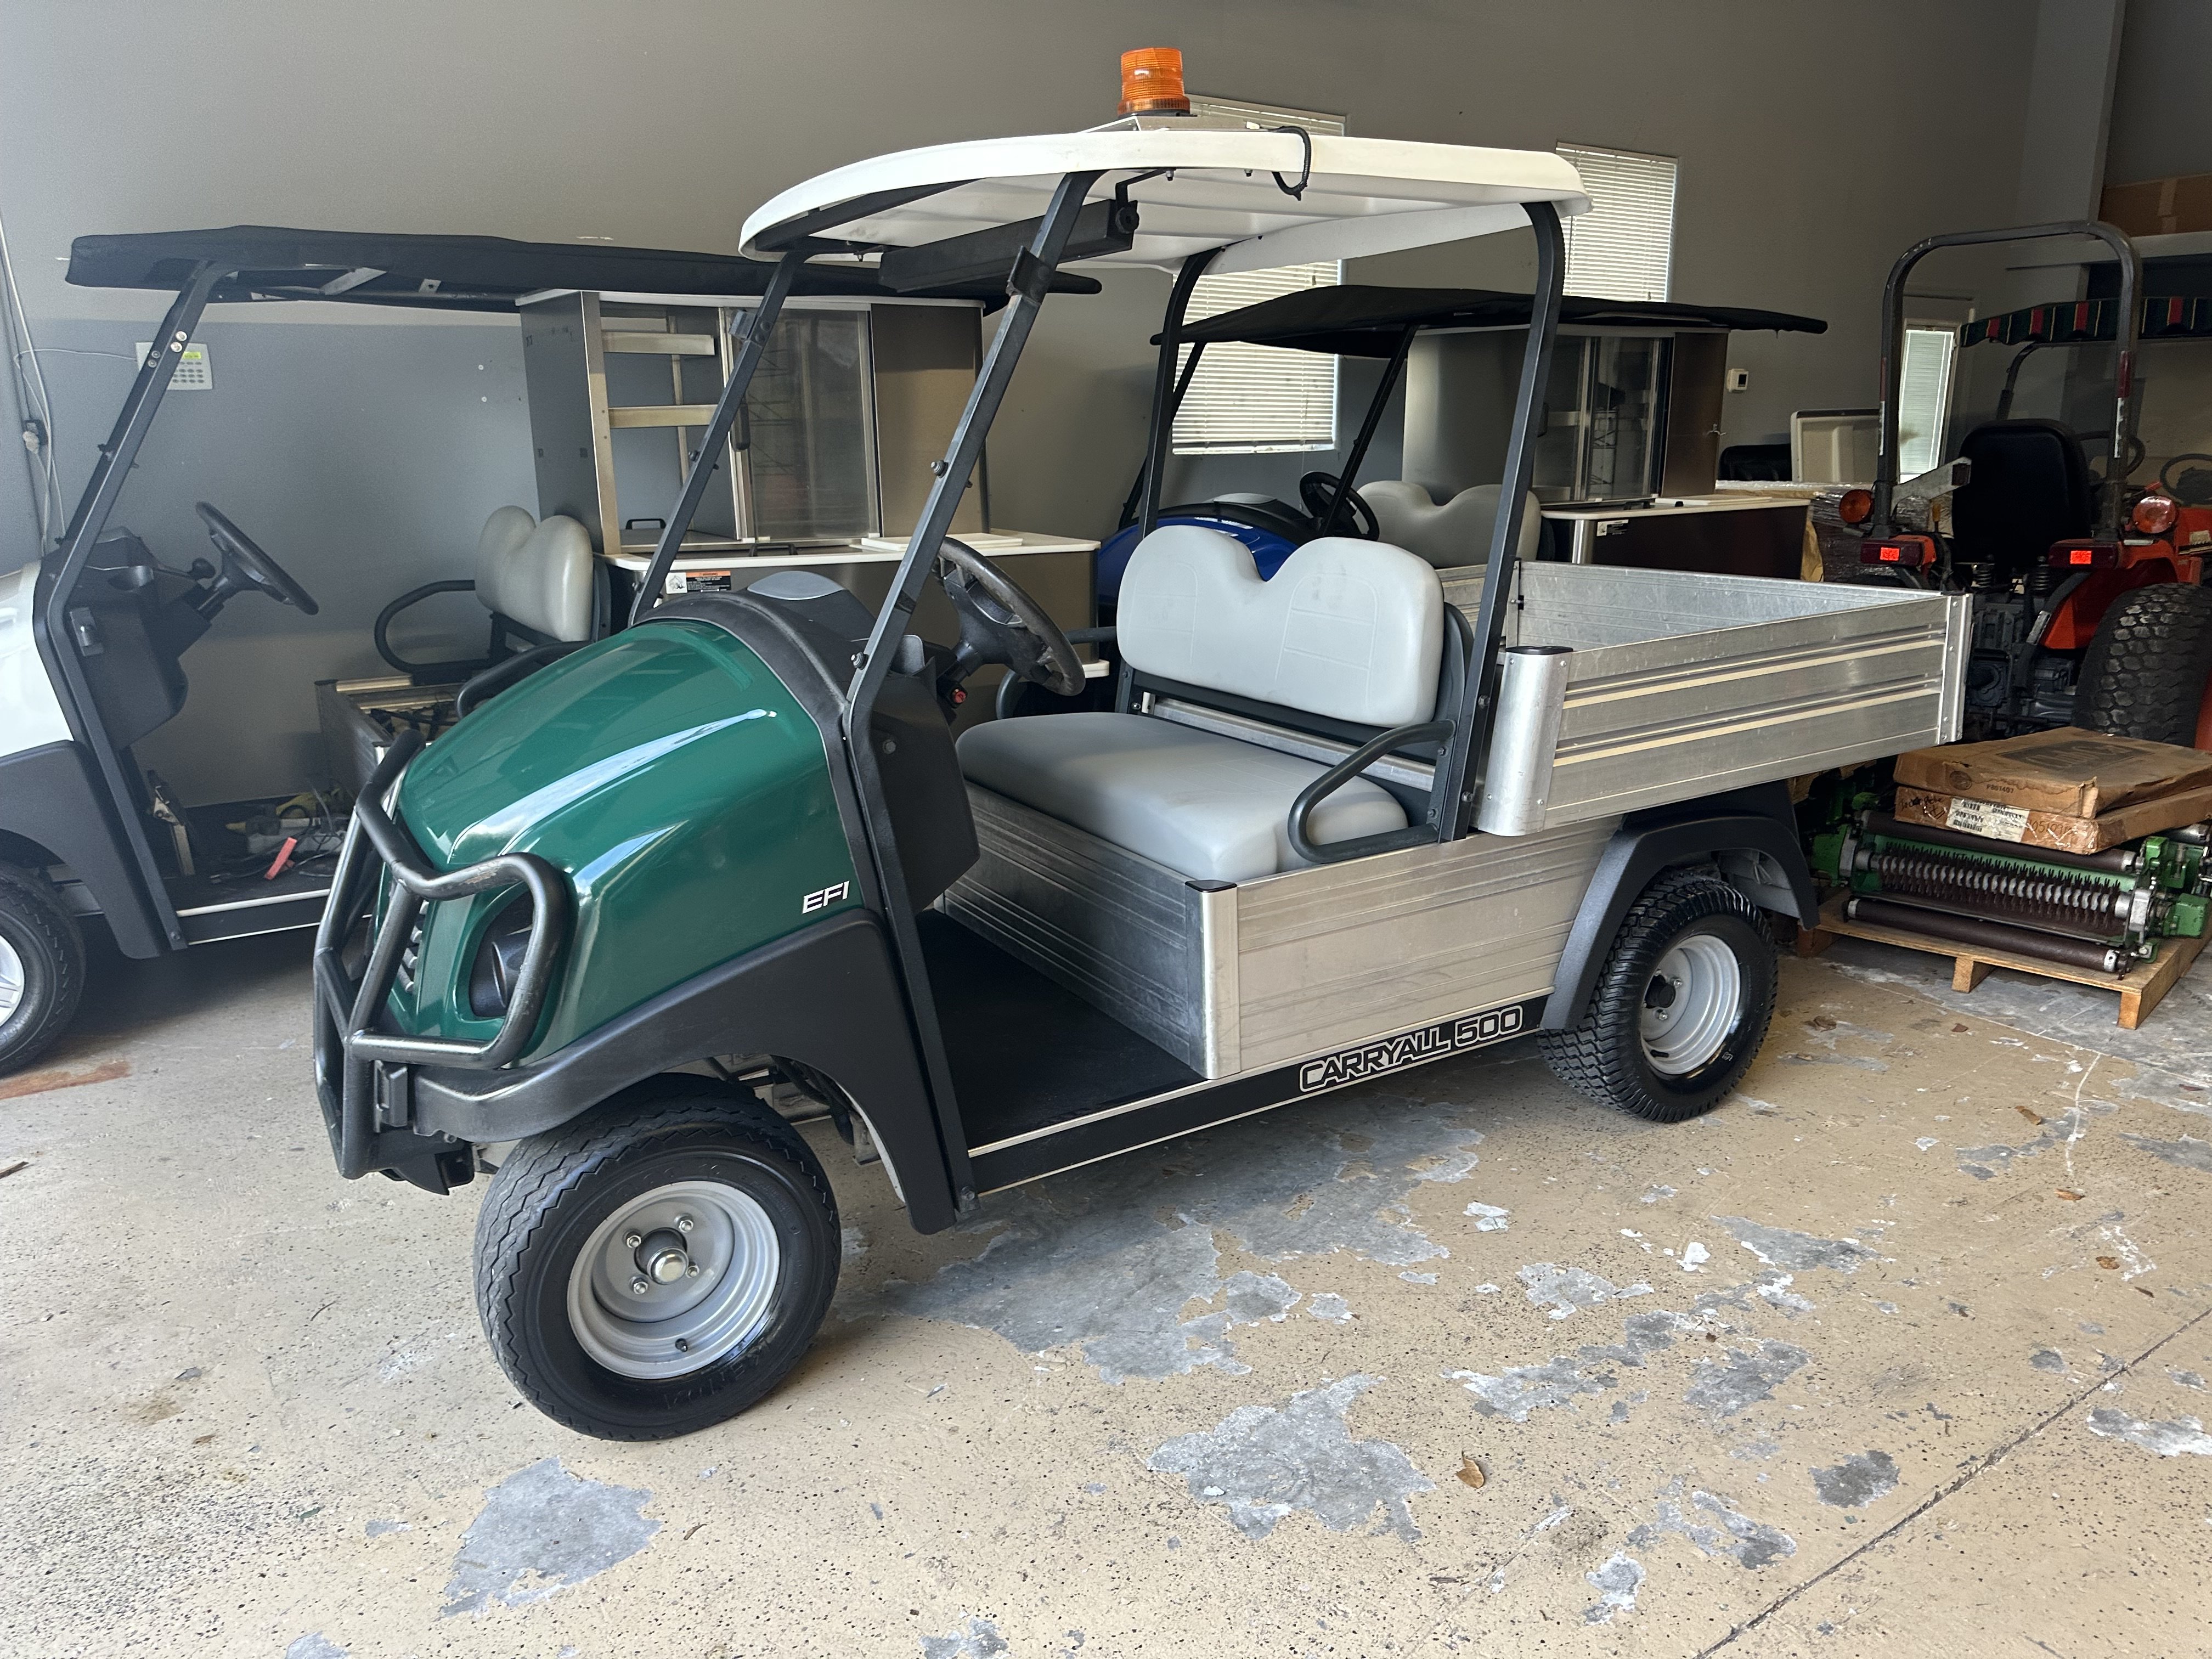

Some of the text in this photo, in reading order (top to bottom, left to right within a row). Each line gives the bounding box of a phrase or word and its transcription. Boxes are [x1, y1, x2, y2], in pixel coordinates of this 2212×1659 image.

[801, 880, 850, 915] EFI
[1299, 1005, 1523, 1092] CARRYALL 500
